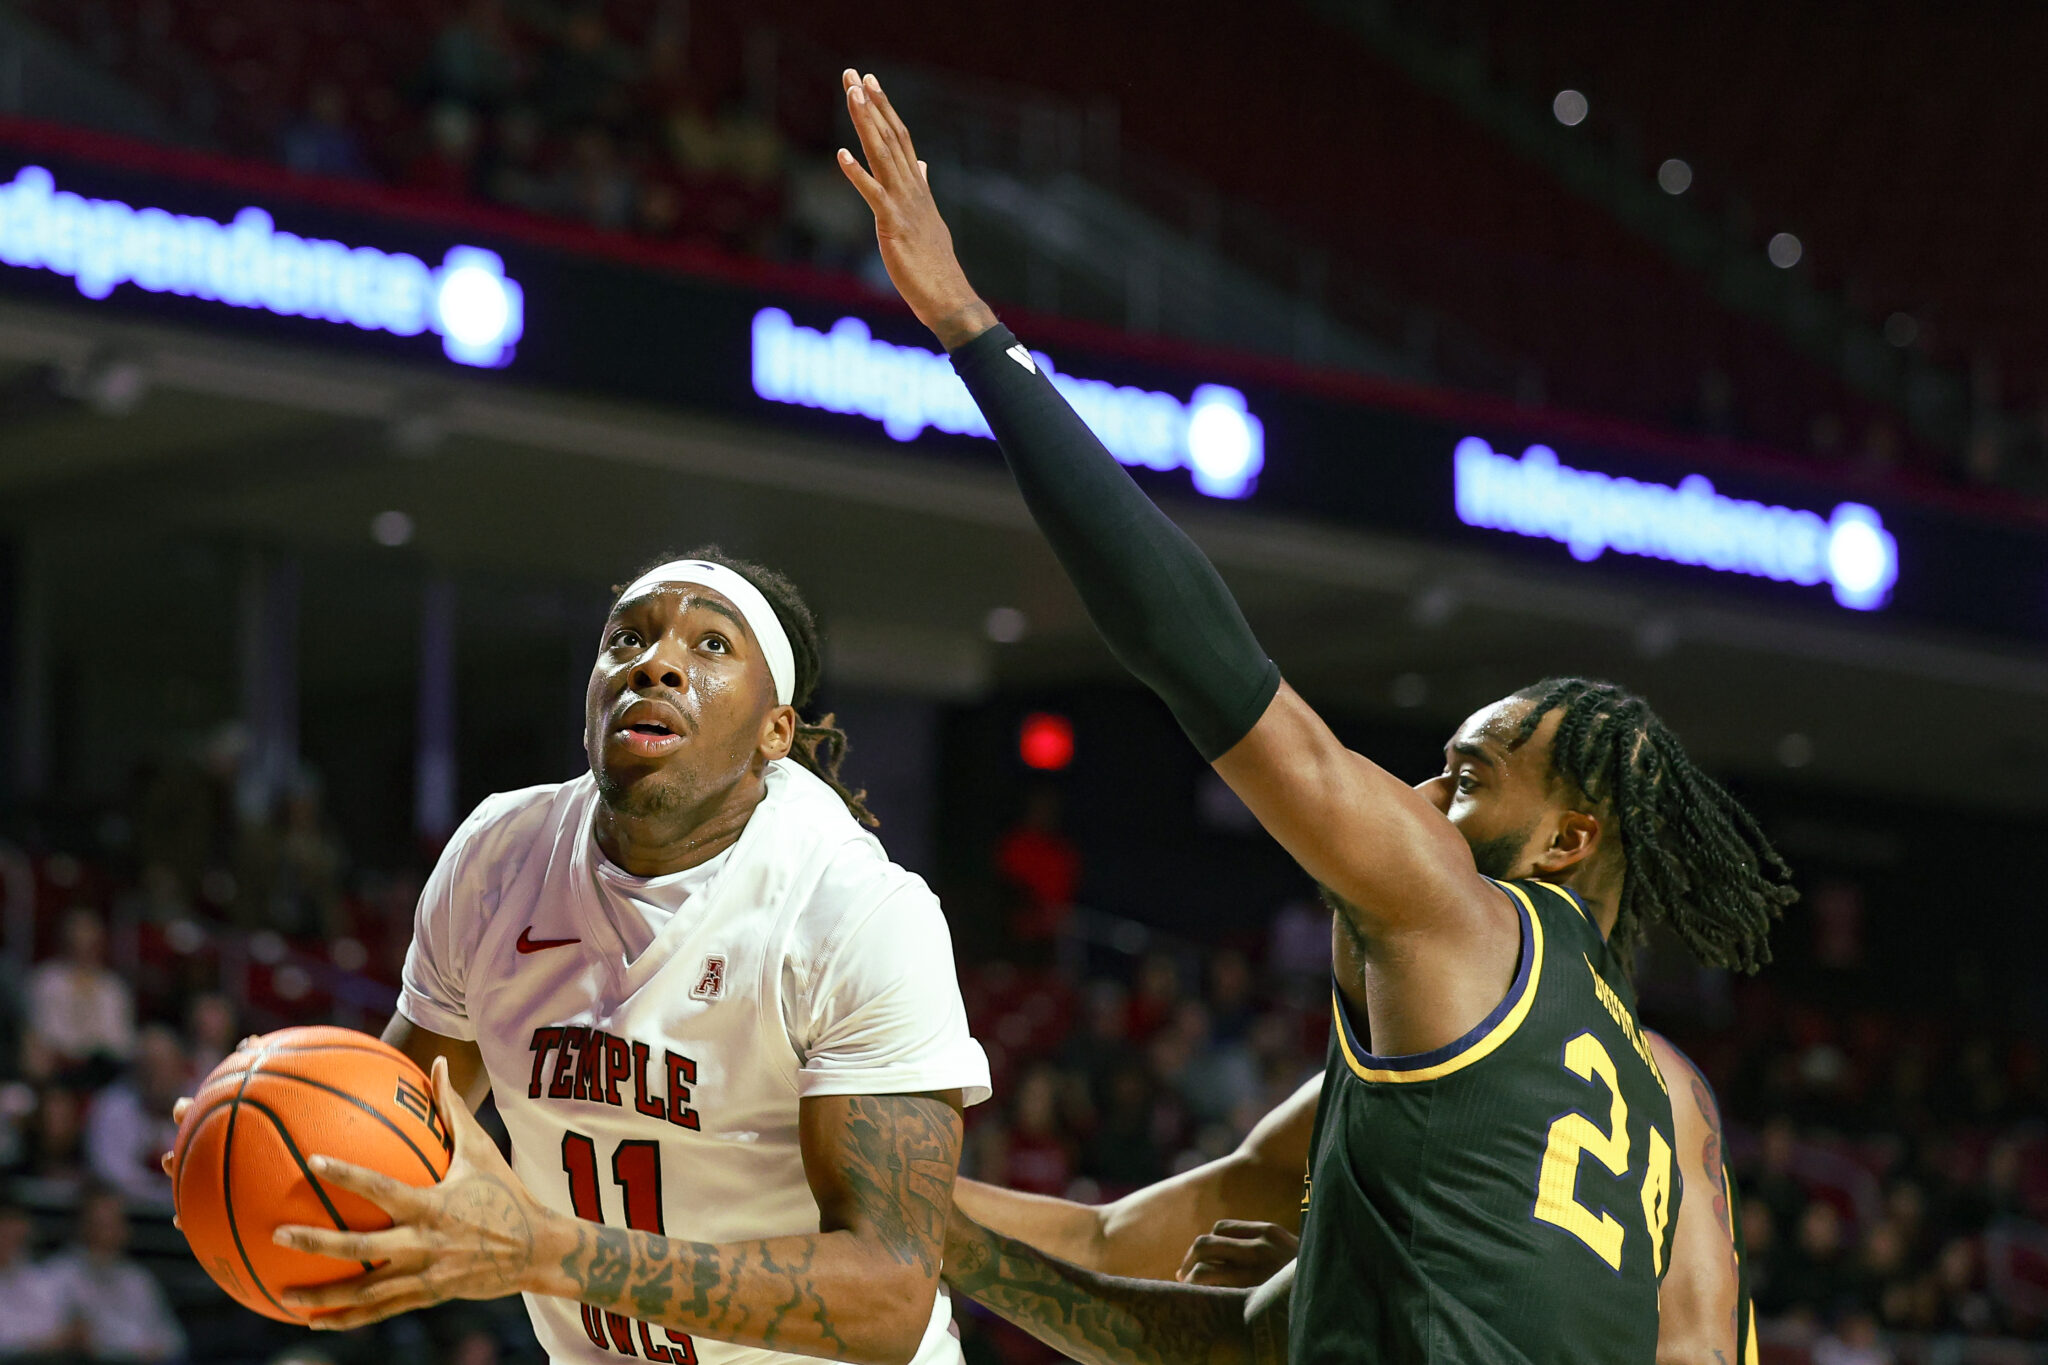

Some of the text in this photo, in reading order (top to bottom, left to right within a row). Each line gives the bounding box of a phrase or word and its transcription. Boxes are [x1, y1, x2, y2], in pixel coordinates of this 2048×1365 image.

[528, 1026, 701, 1132] TEMPLE
[561, 1129, 666, 1238] 11
[1530, 1027, 1674, 1280] 24
